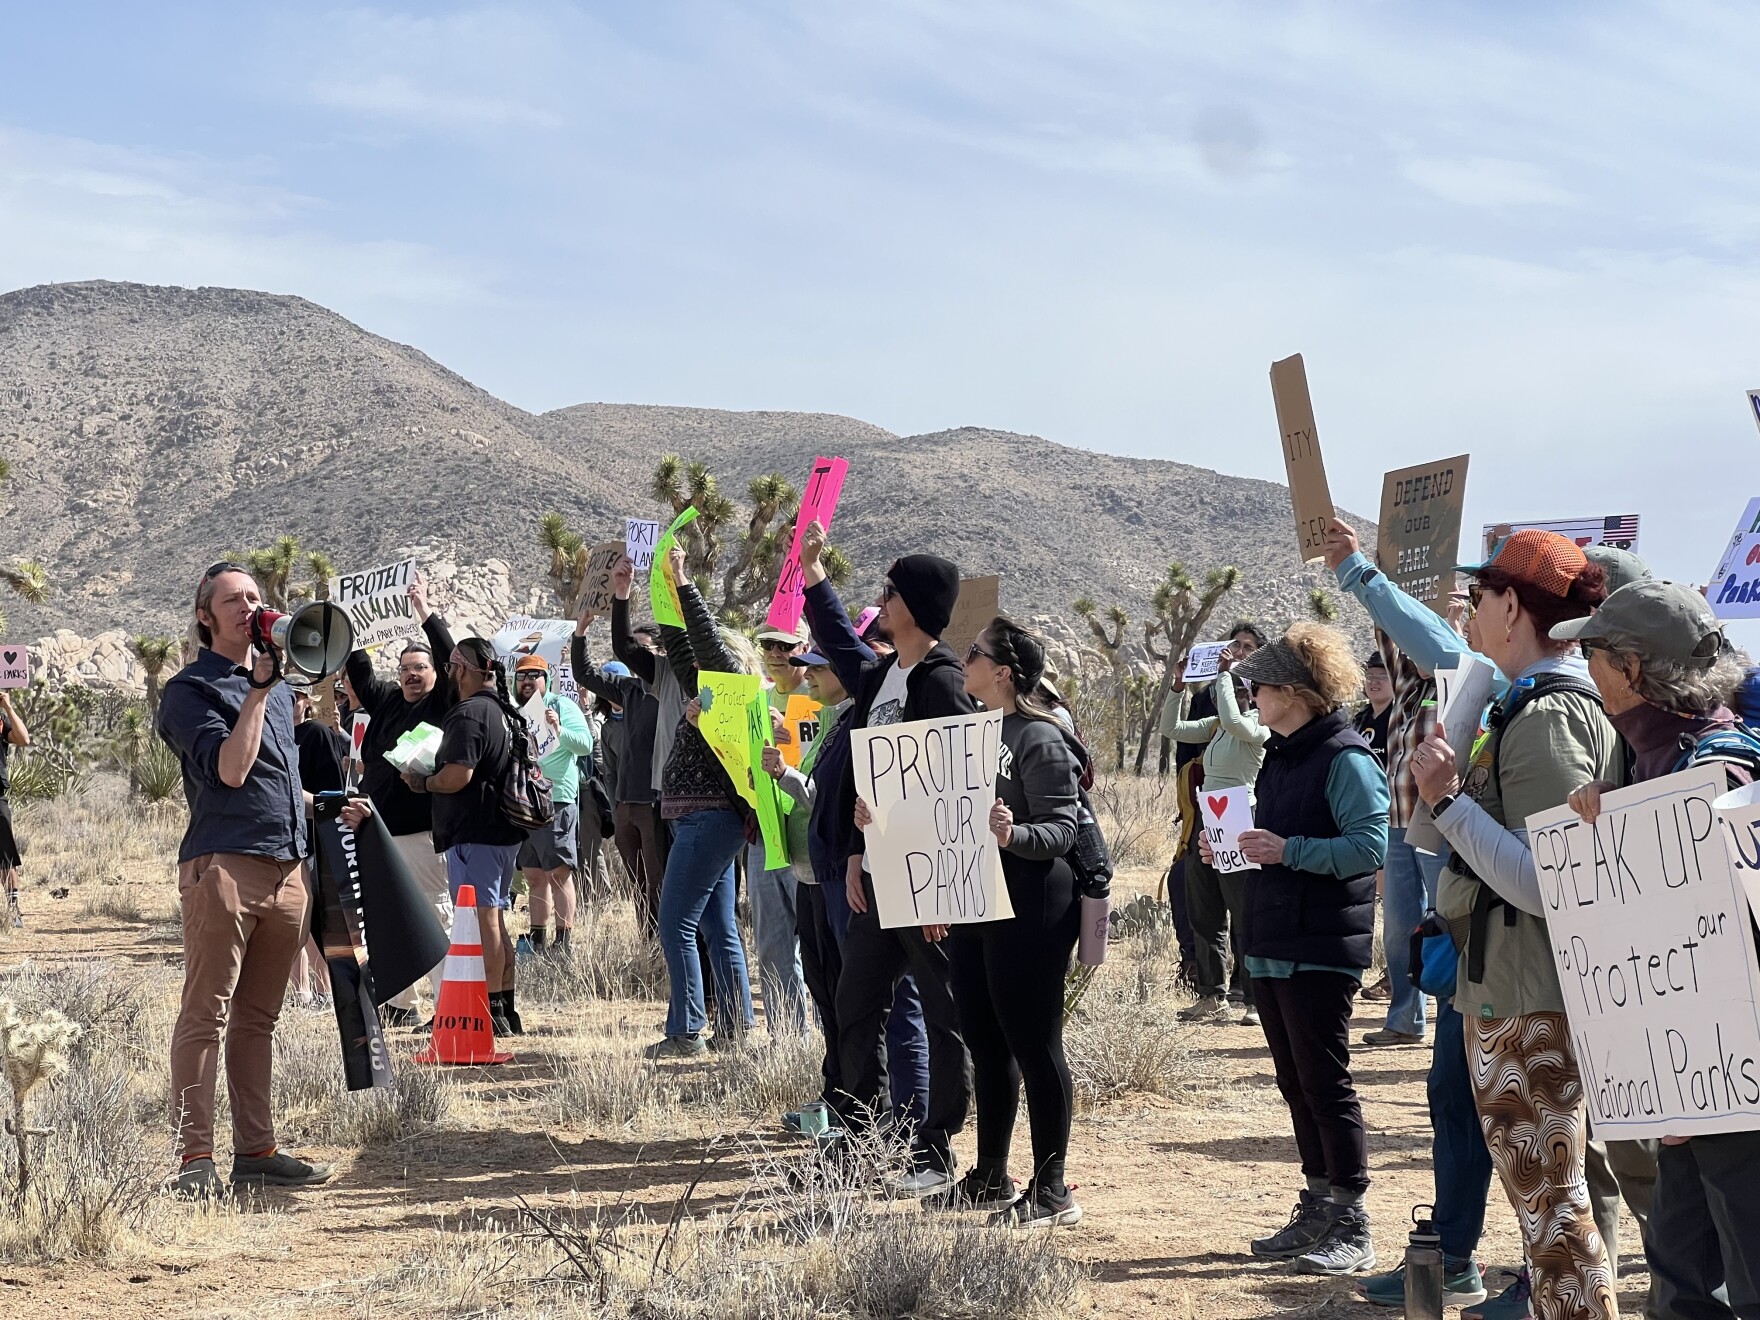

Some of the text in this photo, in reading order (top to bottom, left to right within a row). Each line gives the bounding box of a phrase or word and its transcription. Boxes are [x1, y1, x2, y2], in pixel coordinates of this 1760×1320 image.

[1394, 469, 1454, 507] DEFEND
[1405, 515, 1430, 533] OUR
[1397, 546, 1430, 575] PARK
[340, 561, 411, 602] PROTECT
[377, 628, 394, 642] PARK
[394, 623, 419, 637] RANGERS
[4, 670, 27, 679] PARKS
[560, 669, 569, 678] I
[716, 682, 745, 706] Protect
[719, 712, 733, 724] Our
[934, 796, 976, 845] OUR
[1536, 813, 1641, 911] SPEAK
[1655, 796, 1712, 889] UP
[906, 845, 986, 920] PARKS
[1558, 911, 1727, 1016] to Protect our
[436, 1015, 485, 1032] JOTR
[1577, 1022, 1760, 1120] National Parks
